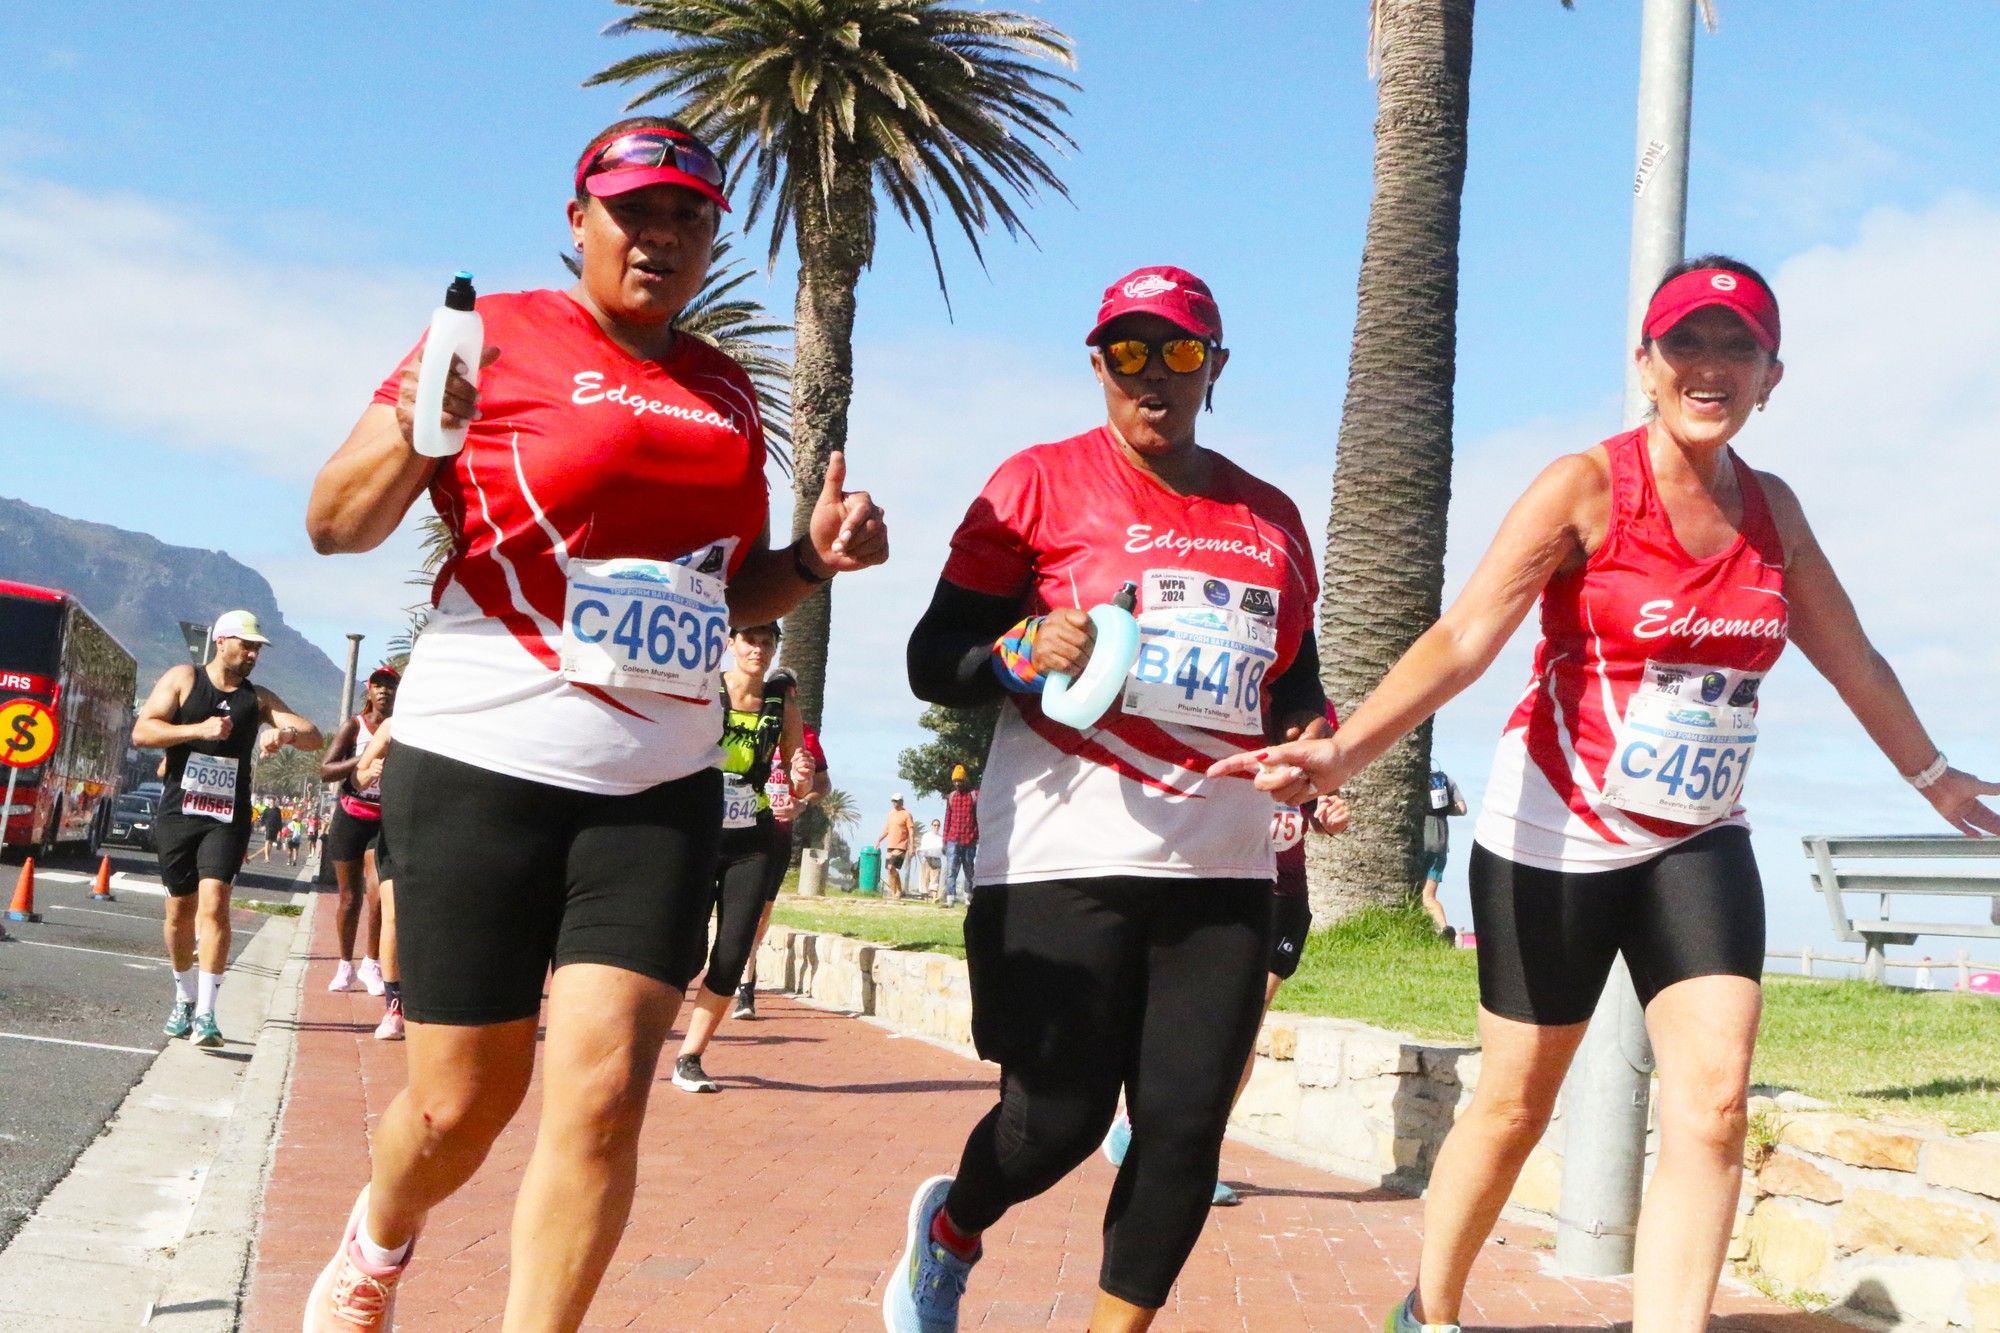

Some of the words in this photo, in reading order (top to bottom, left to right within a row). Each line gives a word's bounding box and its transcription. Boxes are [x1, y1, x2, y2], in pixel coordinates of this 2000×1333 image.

[571, 371, 739, 434] Edgemead
[1124, 523, 1275, 567] Edgemead
[627, 589, 650, 597] FORM
[651, 591, 666, 600] BAY
[690, 576, 703, 594] 15
[1159, 580, 1186, 590] WPA
[1161, 590, 1184, 602] 2024
[1244, 590, 1272, 607] ASA
[571, 599, 727, 673] C4636
[1246, 624, 1258, 640] 15
[1136, 642, 1265, 712] B4418
[1732, 714, 1743, 729] 15
[5, 714, 38, 752] S
[186, 765, 236, 789] D6305
[1620, 740, 1751, 801] C4561
